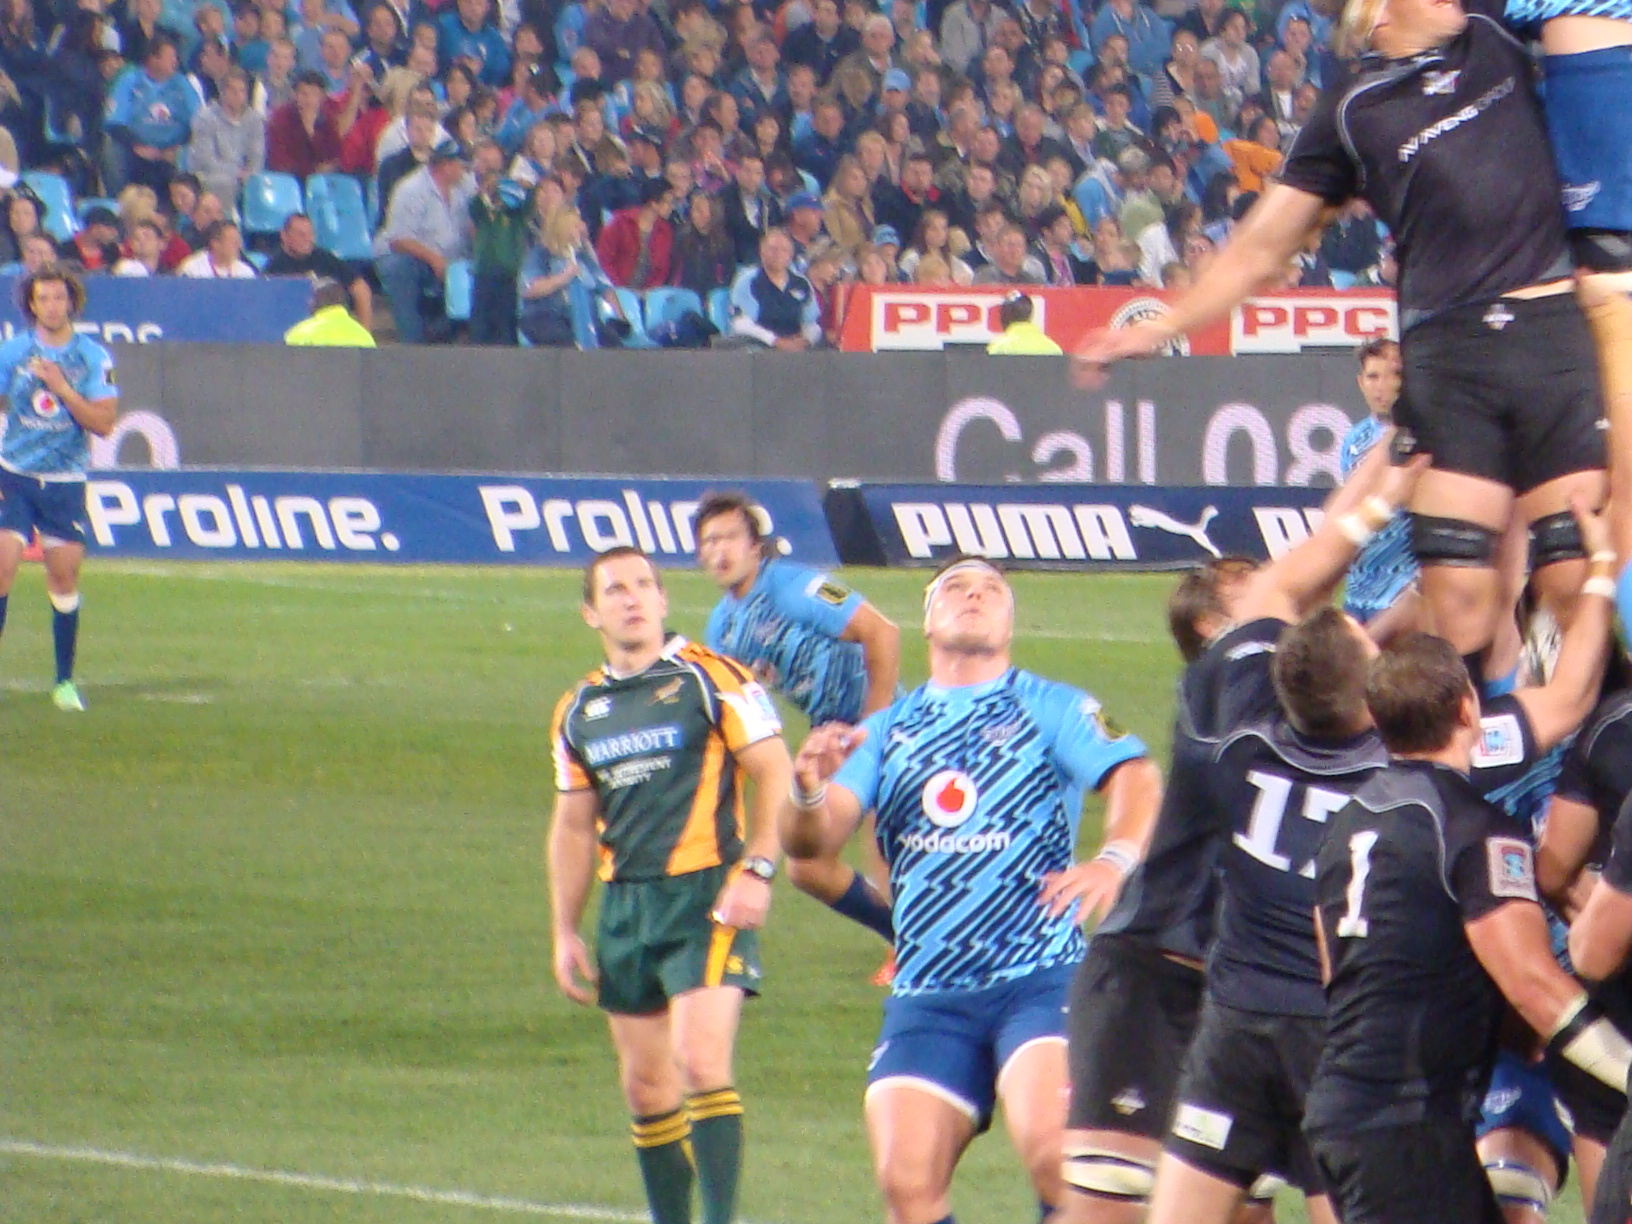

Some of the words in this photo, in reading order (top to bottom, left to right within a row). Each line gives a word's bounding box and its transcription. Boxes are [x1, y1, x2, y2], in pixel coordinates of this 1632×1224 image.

[1243, 305, 1391, 338] PPC
[934, 396, 1156, 484] Call
[890, 502, 1139, 560] PUMA
[896, 826, 1010, 855] vodacom
[1336, 830, 1379, 938] 1
